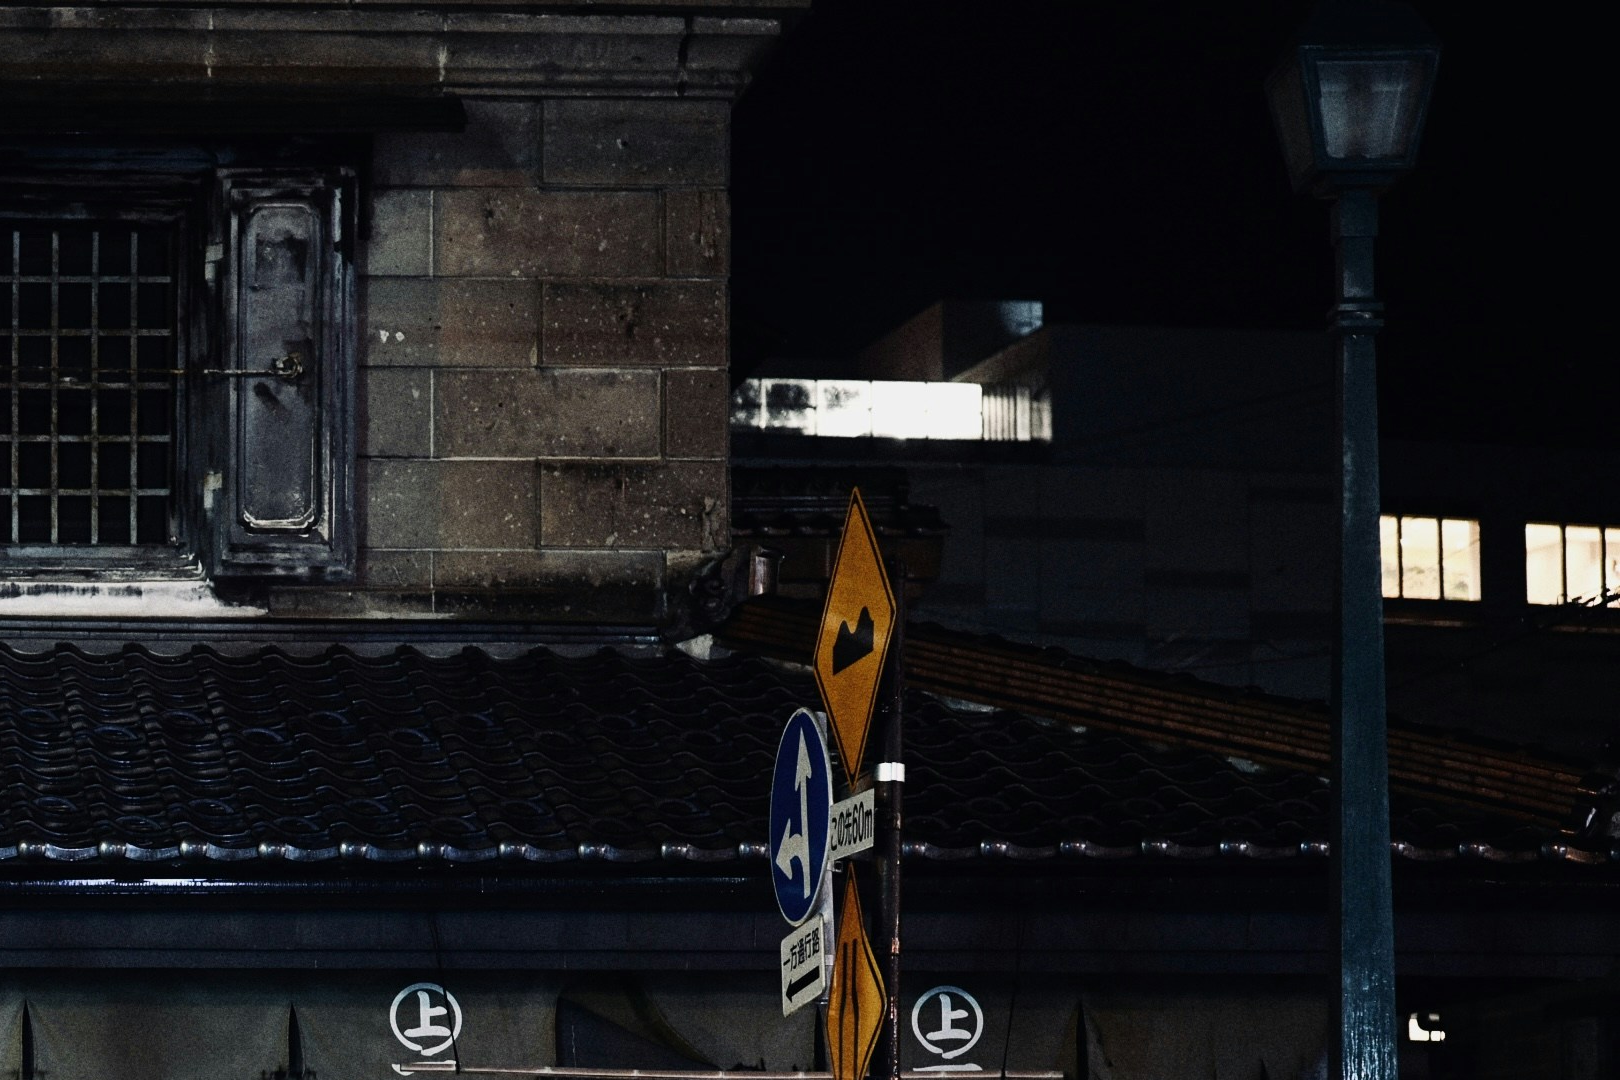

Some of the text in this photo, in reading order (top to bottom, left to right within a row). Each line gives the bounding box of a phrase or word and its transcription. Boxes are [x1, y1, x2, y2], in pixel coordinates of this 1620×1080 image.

[831, 801, 872, 851] この先60m
[784, 927, 819, 970] 一方通行路
